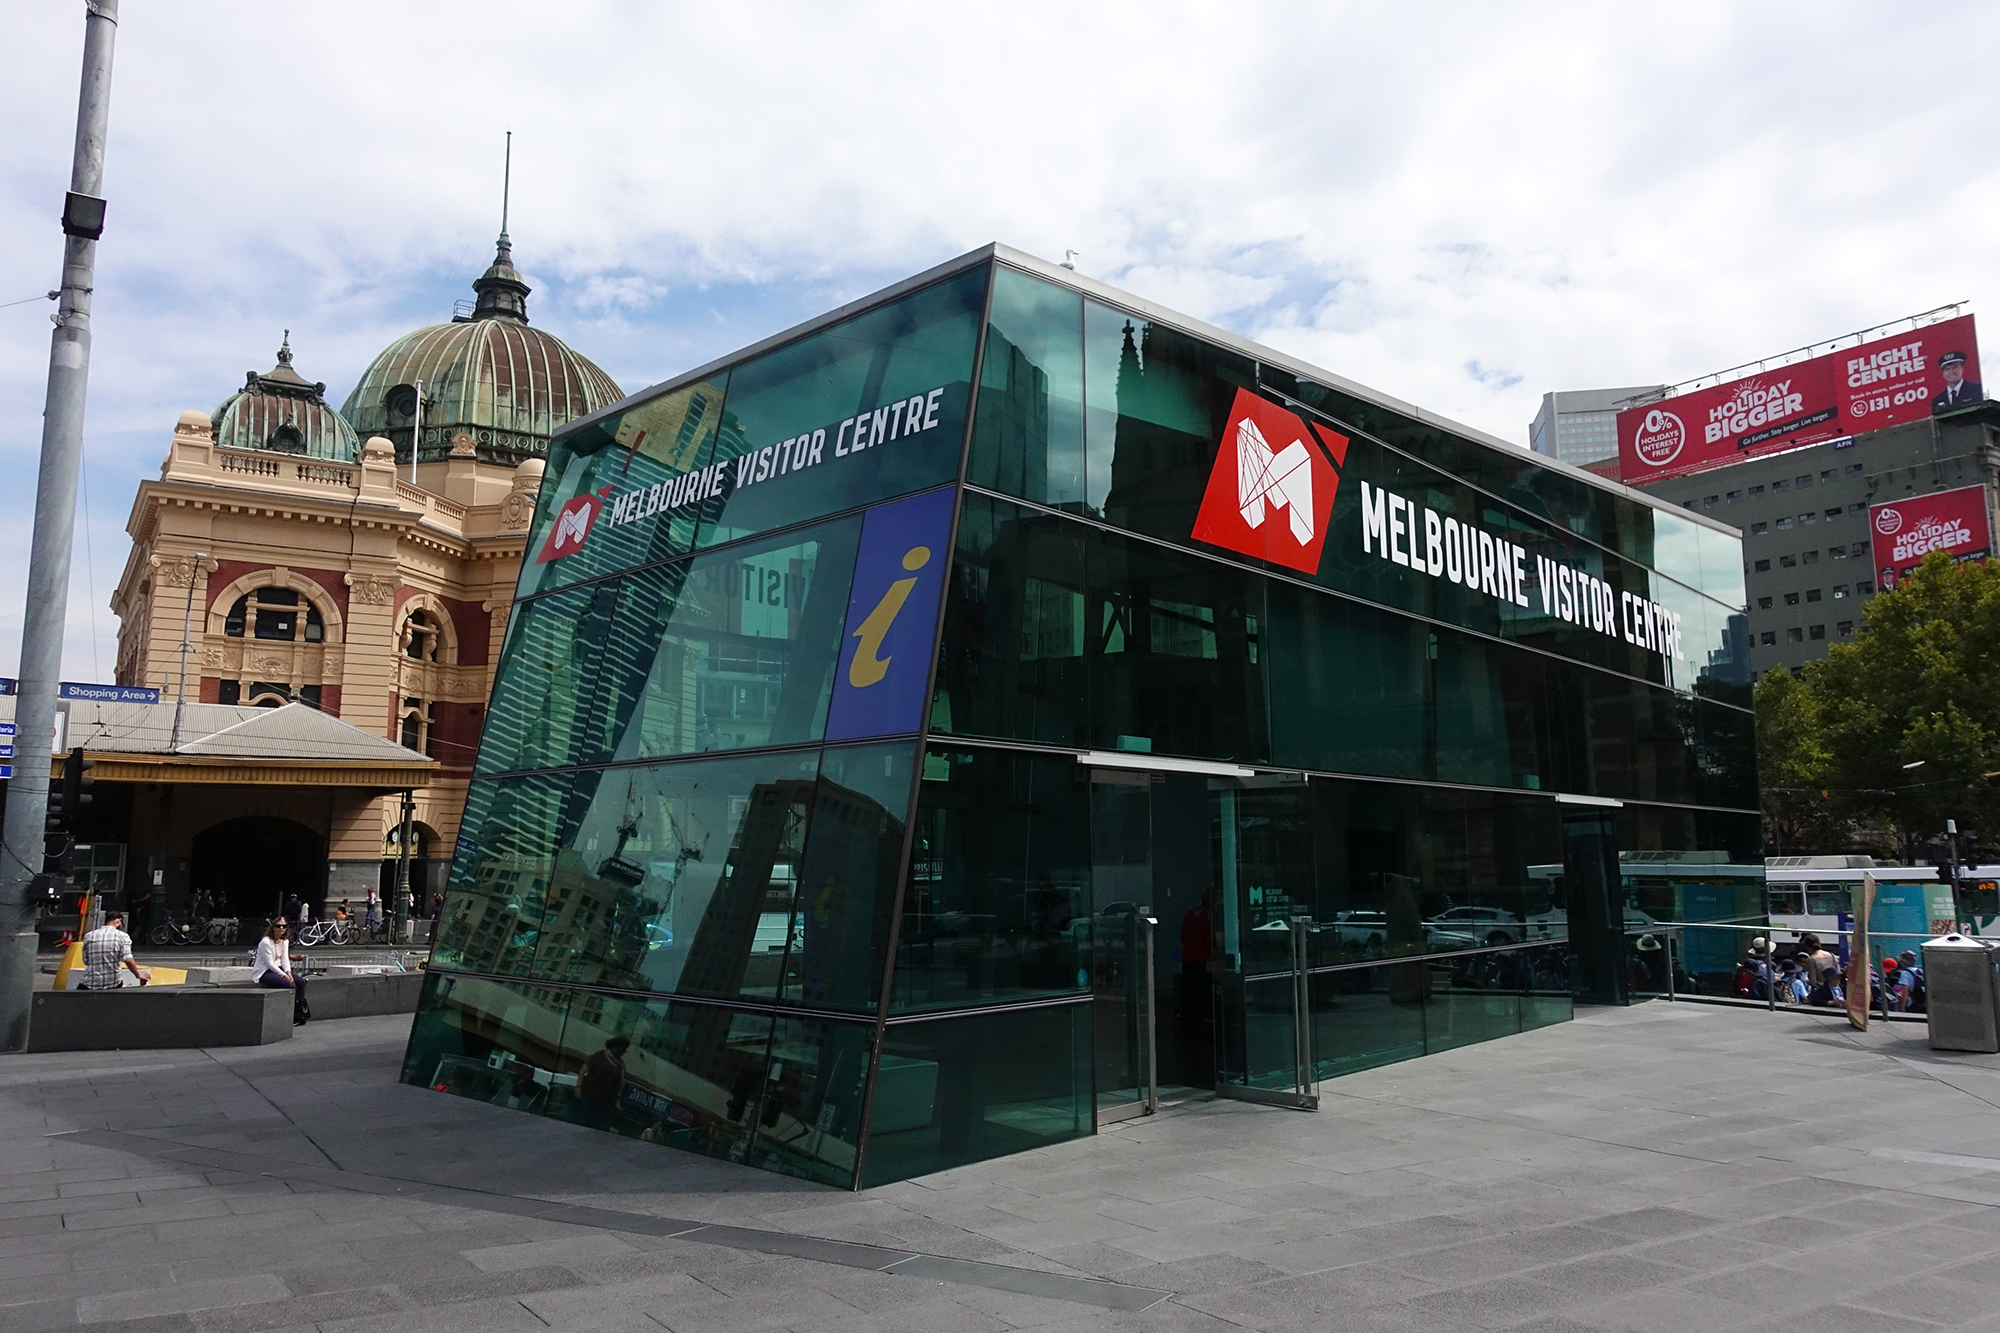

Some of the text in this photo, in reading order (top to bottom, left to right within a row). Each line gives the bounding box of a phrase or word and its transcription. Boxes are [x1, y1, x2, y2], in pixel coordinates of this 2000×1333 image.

[1847, 341, 1923, 375] FLIGHT
[1847, 356, 1925, 388] CENTRE
[1709, 379, 1792, 423] HOLIDAY
[1850, 392, 1865, 400] Book
[1869, 386, 1929, 412] 131 600
[1645, 409, 1673, 433] 0%
[1704, 392, 1804, 444] BIGGER
[1742, 437, 1751, 445] Go
[1751, 432, 1770, 443] further.
[1770, 428, 1782, 437] Stay
[1782, 422, 1800, 432] longer.
[1800, 417, 1812, 426] Live
[1641, 429, 1679, 446] HOLIDAYS
[1642, 437, 1679, 453] INTEREST
[1836, 440, 1852, 448] APN
[608, 460, 729, 529] MELBOURNE
[735, 428, 826, 489] VISITOR
[834, 387, 944, 458] CENTRE
[1892, 528, 1972, 562] BIGGER
[1896, 518, 1962, 546] HOLIDAY
[1360, 480, 1529, 608] MELBOURNE
[1536, 554, 1617, 638] VISITOR
[1621, 590, 1685, 661] CENTRE
[68, 686, 146, 700] Shopping Area
